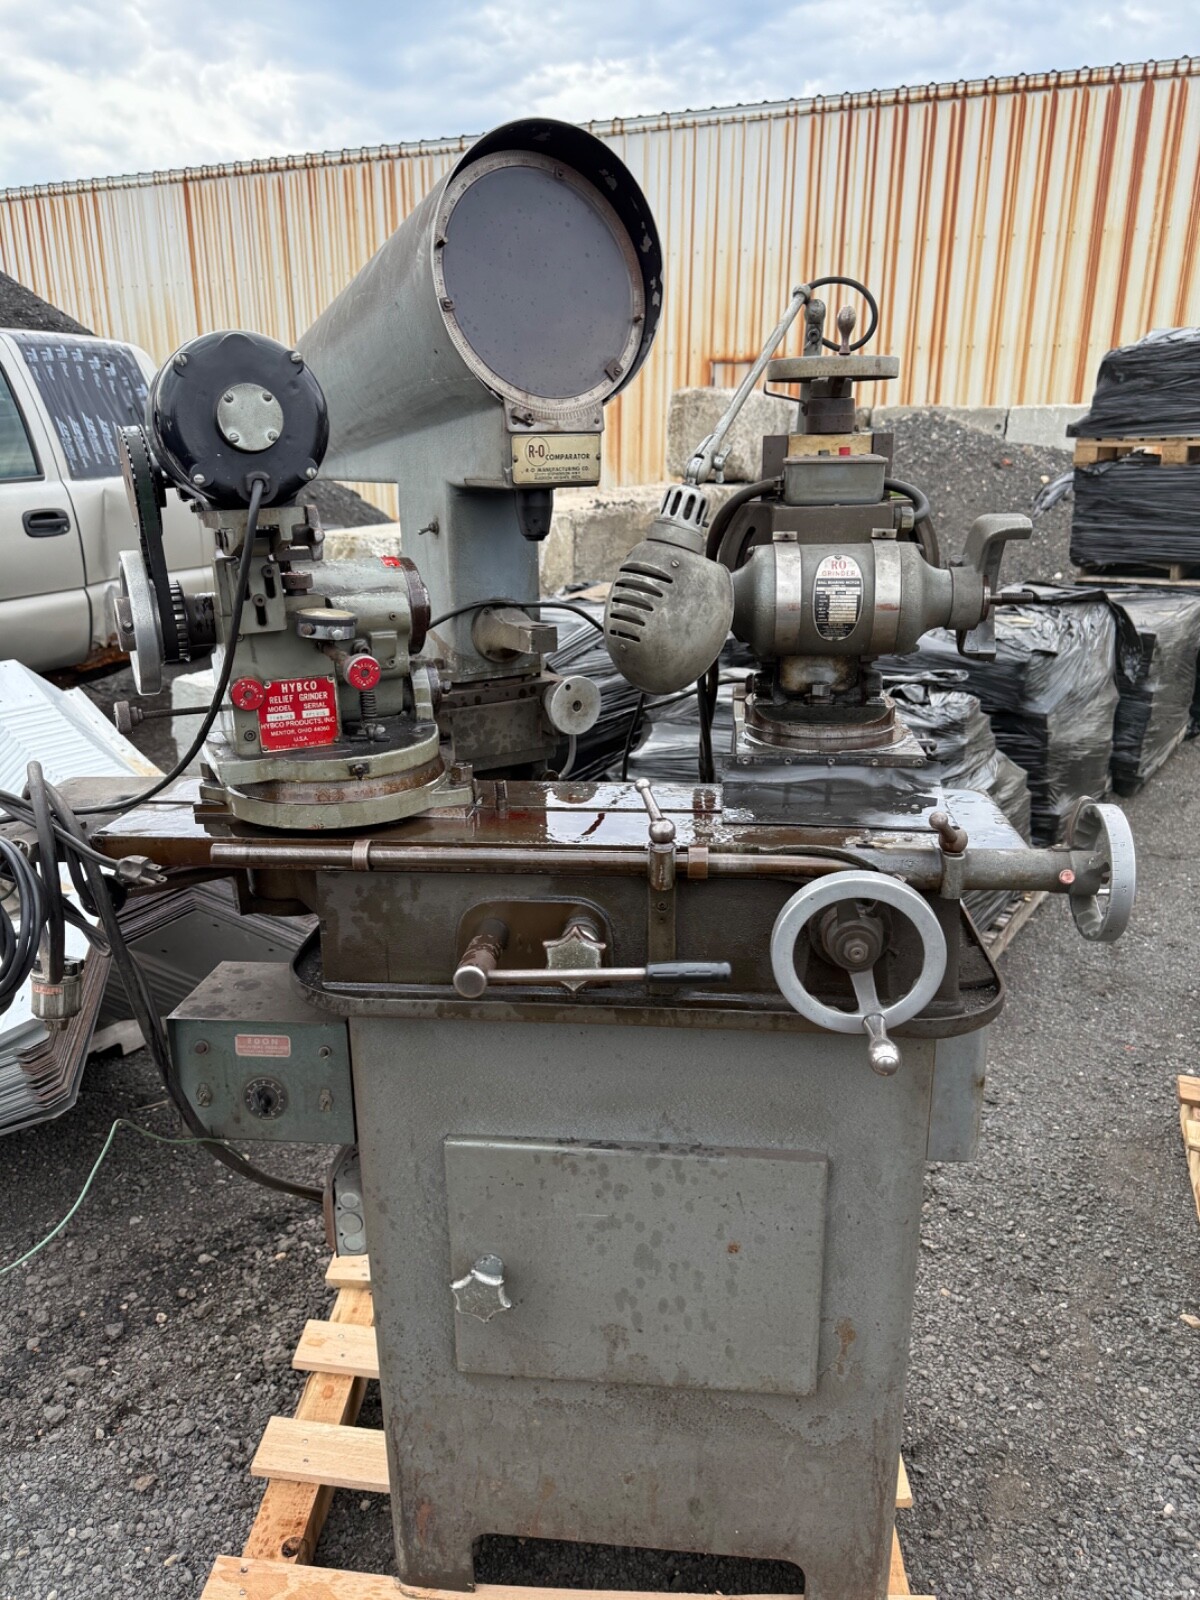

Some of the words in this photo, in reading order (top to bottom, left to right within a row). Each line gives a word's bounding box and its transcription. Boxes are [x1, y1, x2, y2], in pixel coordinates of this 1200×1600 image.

[528, 444, 545, 458] R-O
[545, 453, 590, 461] COMPARATOR
[831, 560, 847, 570] RO
[280, 680, 317, 693] HYBCO
[269, 695, 294, 704] RELIEF
[298, 691, 328, 701] GRINDER
[267, 704, 292, 713] MODEL
[303, 701, 327, 709] SERIAL
[261, 721, 285, 730] HYBCO
